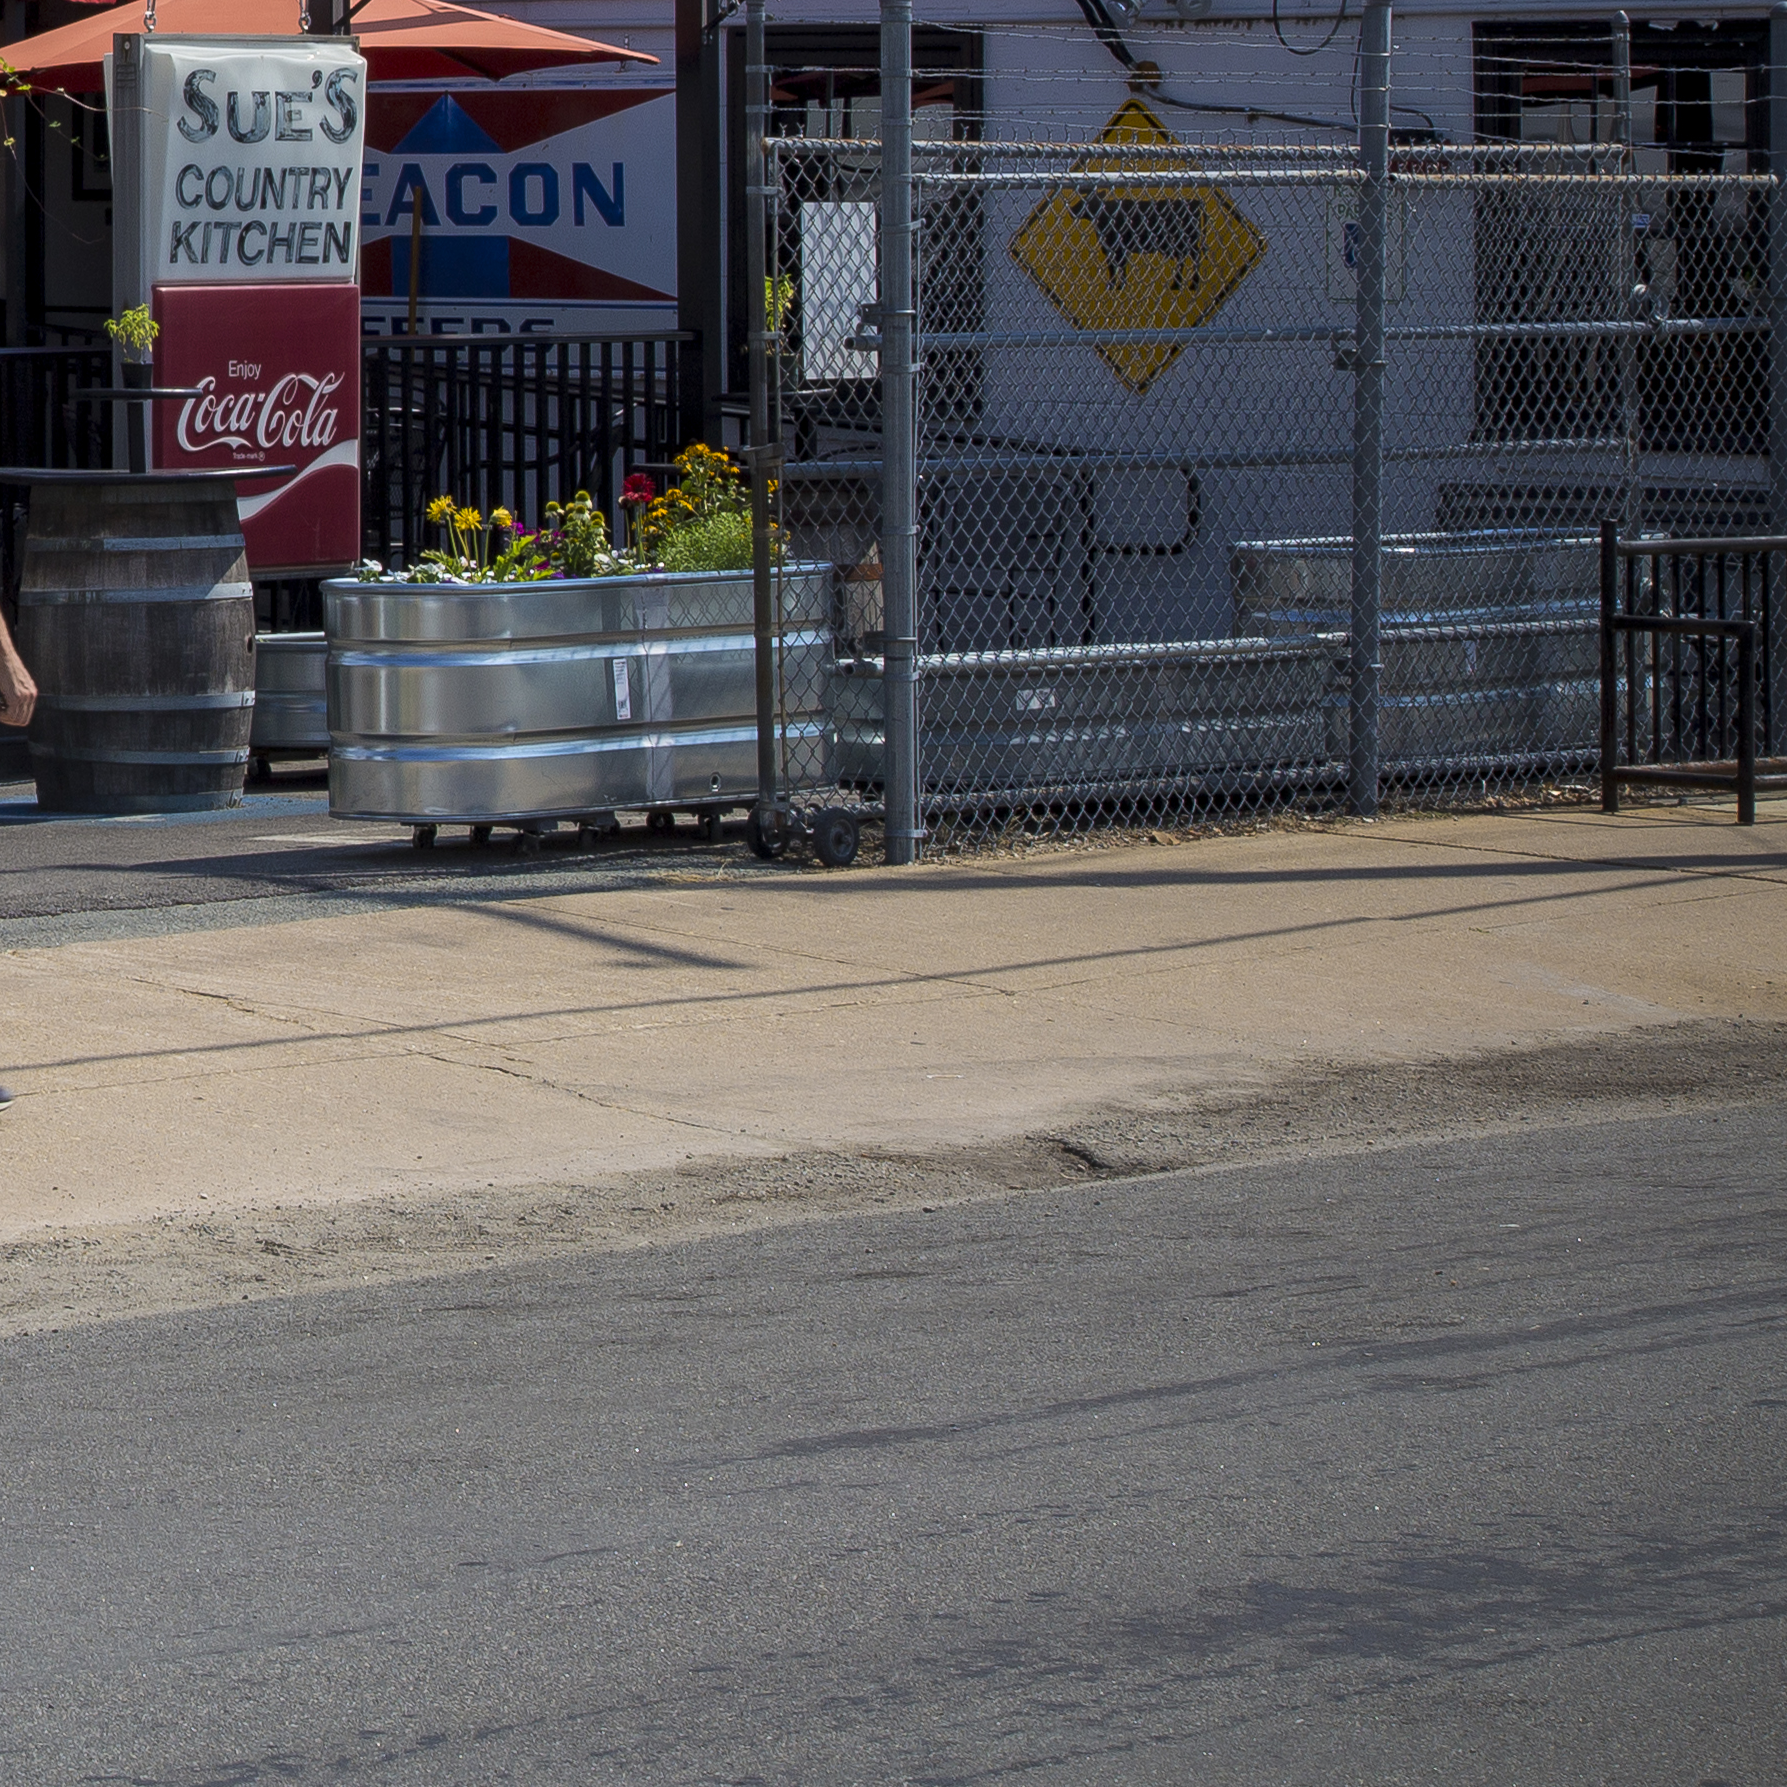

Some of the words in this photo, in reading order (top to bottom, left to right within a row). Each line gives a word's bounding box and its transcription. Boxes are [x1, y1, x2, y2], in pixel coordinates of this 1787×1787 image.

[176, 67, 358, 144] SUE'S
[176, 164, 353, 211] COUNTRY
[169, 220, 351, 266] KITCHEN
[228, 360, 262, 380] Enjoy
[177, 372, 345, 452] Coca-Cola
